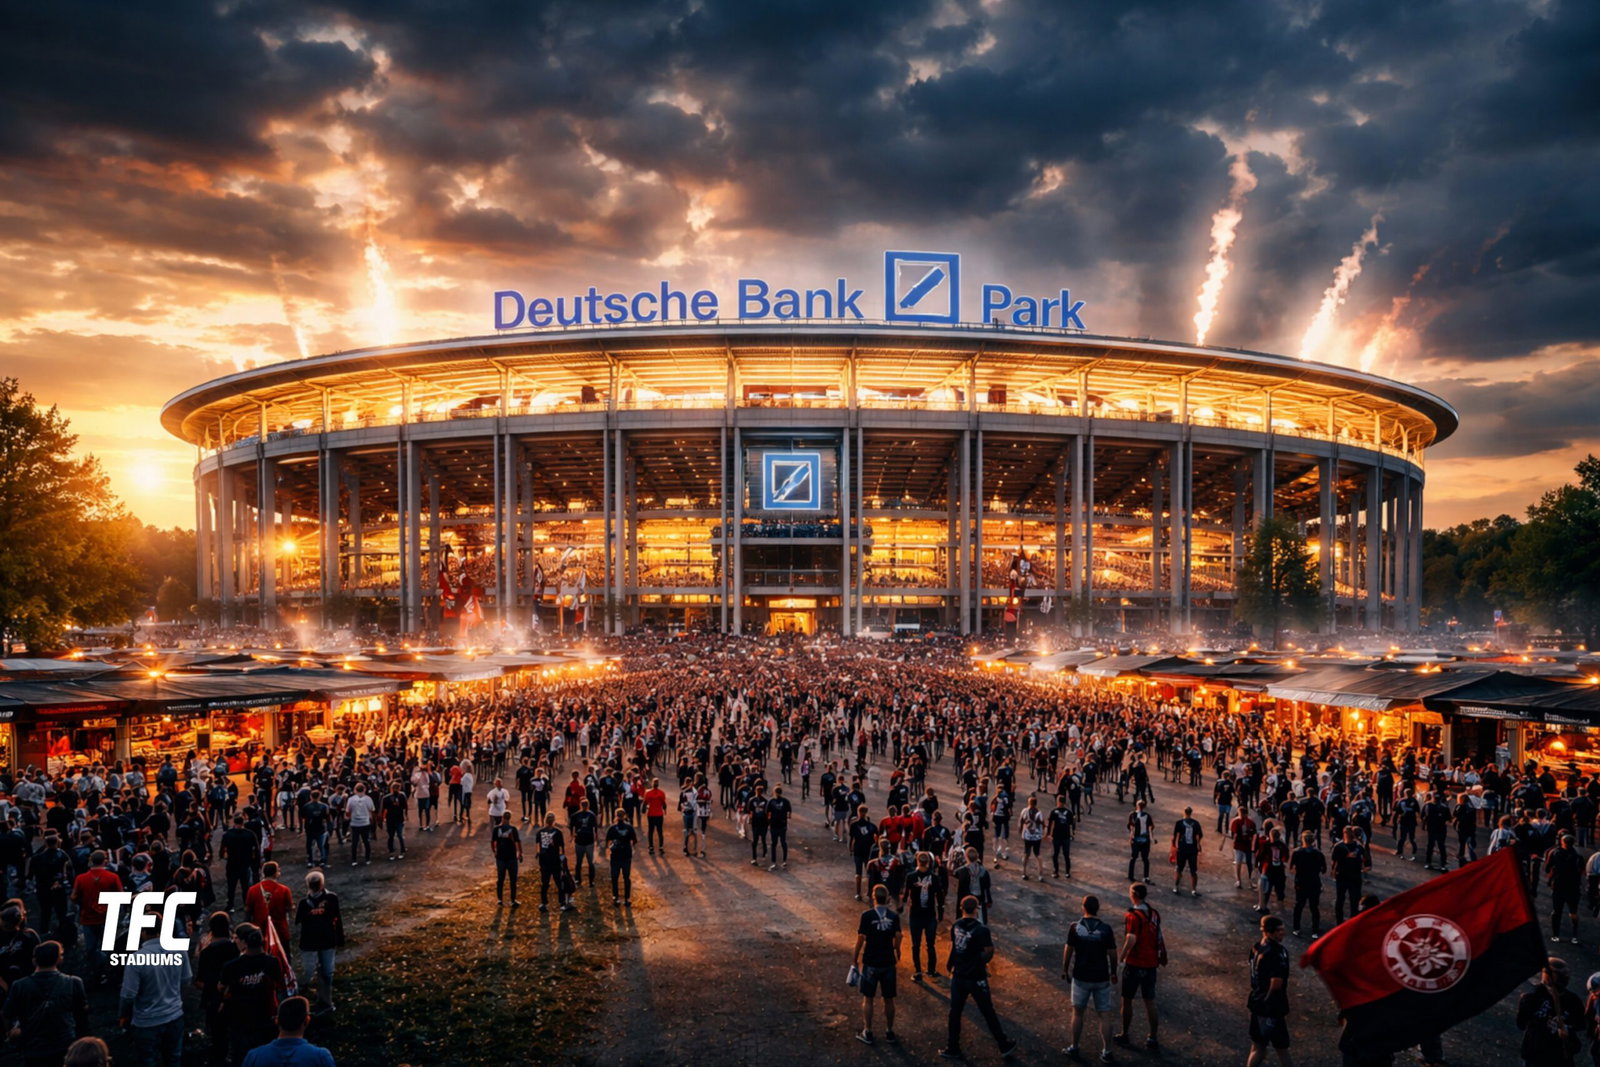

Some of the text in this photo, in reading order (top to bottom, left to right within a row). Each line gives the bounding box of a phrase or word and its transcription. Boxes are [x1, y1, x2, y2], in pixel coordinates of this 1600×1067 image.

[494, 278, 1087, 330] Deutsche Bank Park
